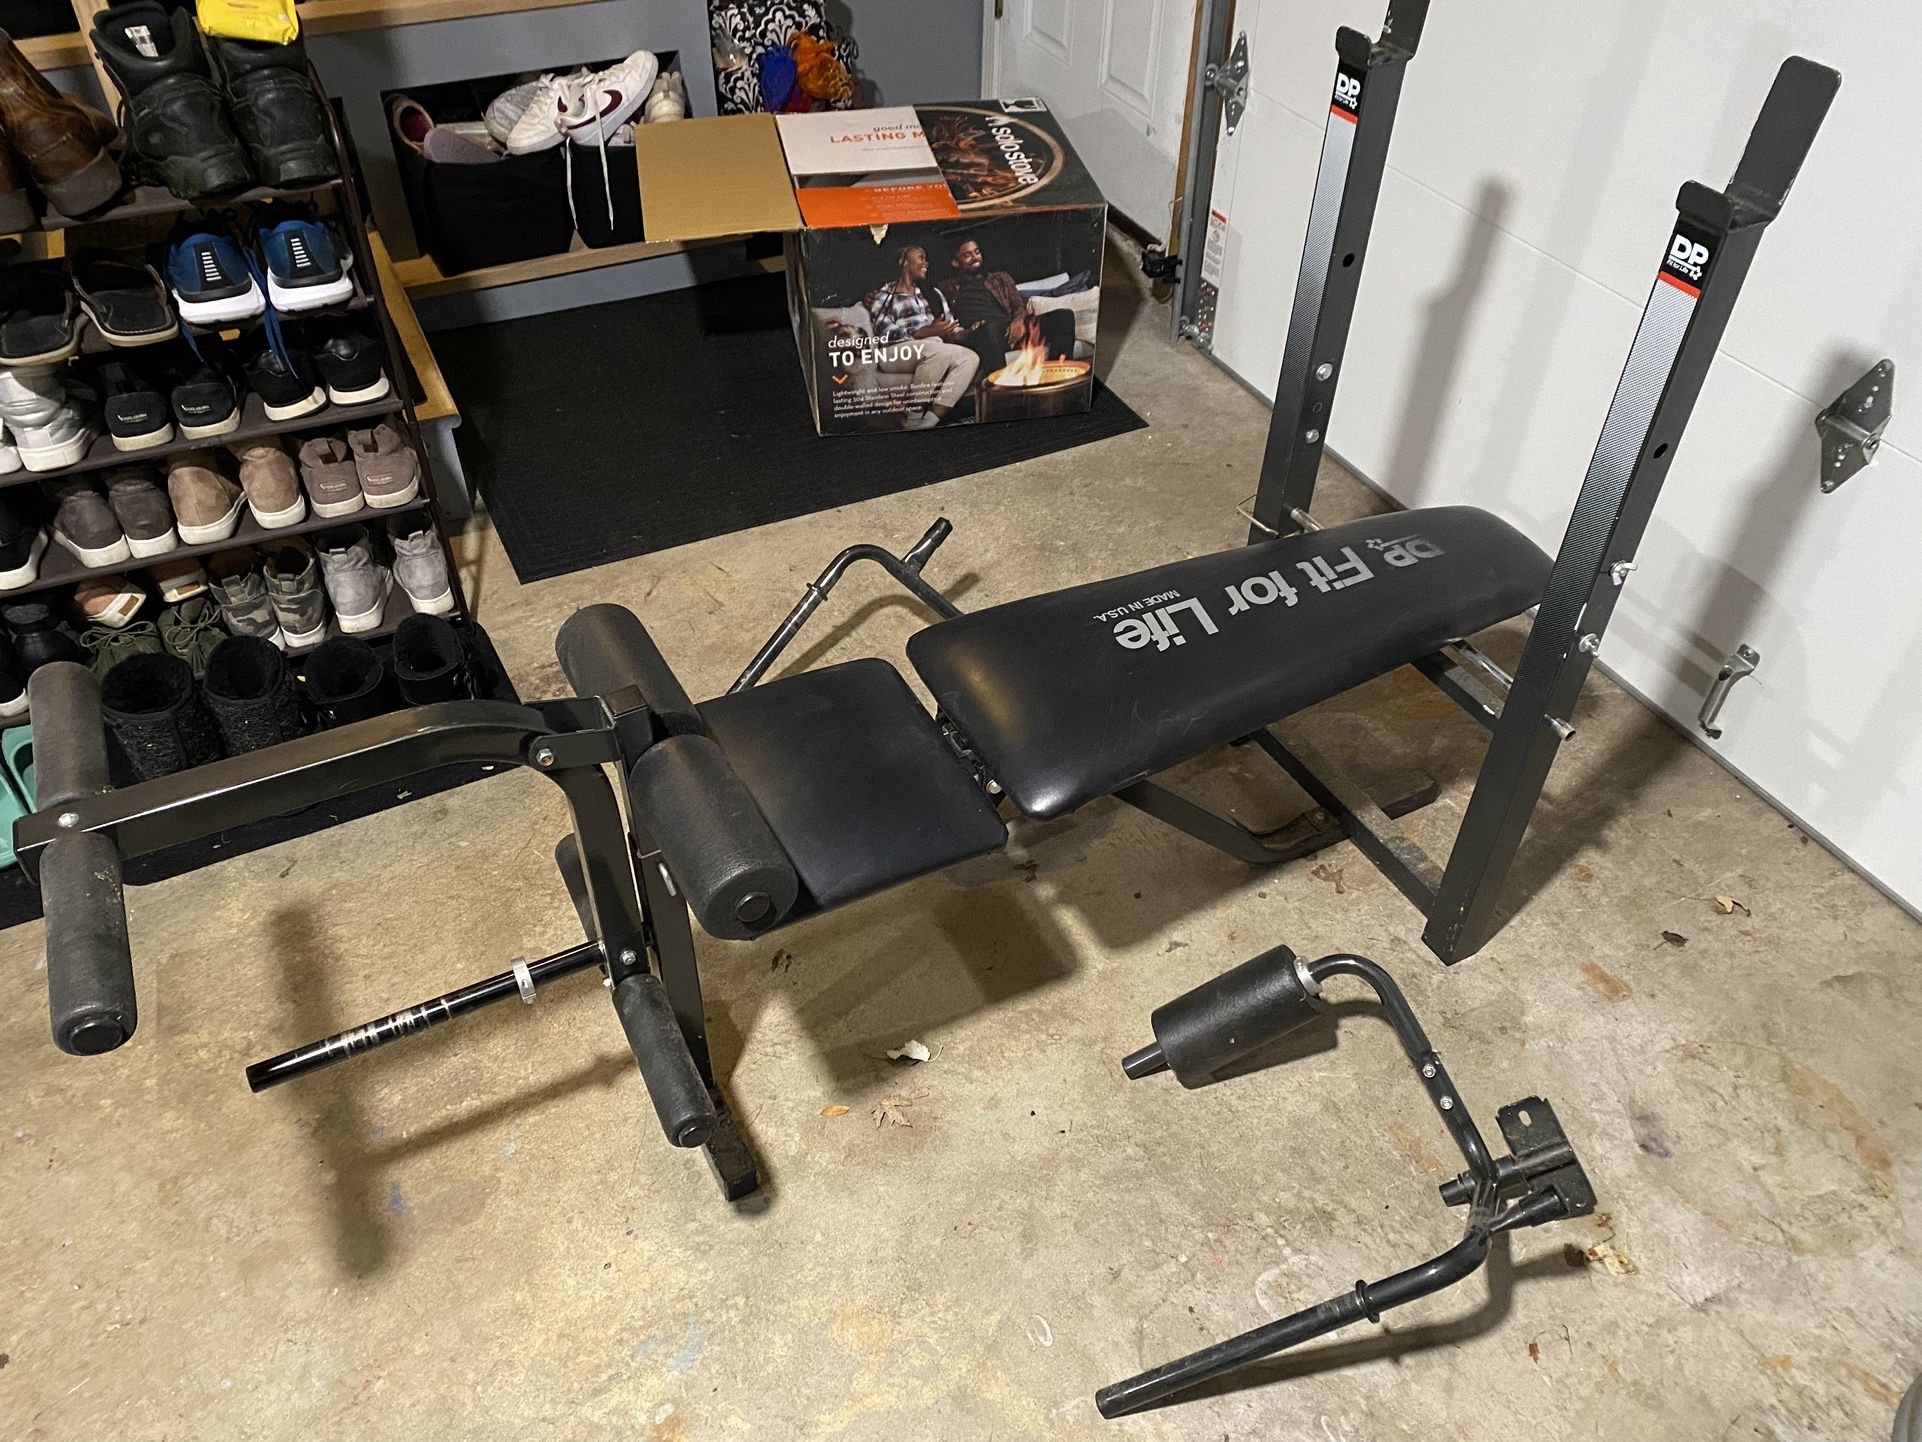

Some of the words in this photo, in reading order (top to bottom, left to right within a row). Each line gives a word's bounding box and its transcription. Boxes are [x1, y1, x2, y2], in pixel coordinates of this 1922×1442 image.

[1336, 72, 1361, 97] DP
[830, 132, 906, 143] LASTING
[873, 123, 903, 132] good
[1670, 234, 1709, 265] DP
[828, 331, 890, 348] designed
[829, 351, 855, 367] TO
[861, 344, 925, 364] ENJOY
[833, 388, 865, 397] Lightweight
[910, 381, 930, 389] Bonfire
[834, 410, 864, 419] enjoyment
[1384, 537, 1446, 568] DP
[1296, 546, 1376, 593] Fit
[1142, 589, 1181, 607] MADE
[1223, 570, 1299, 616] for
[1127, 601, 1145, 612] IN
[1113, 597, 1220, 652] Life
